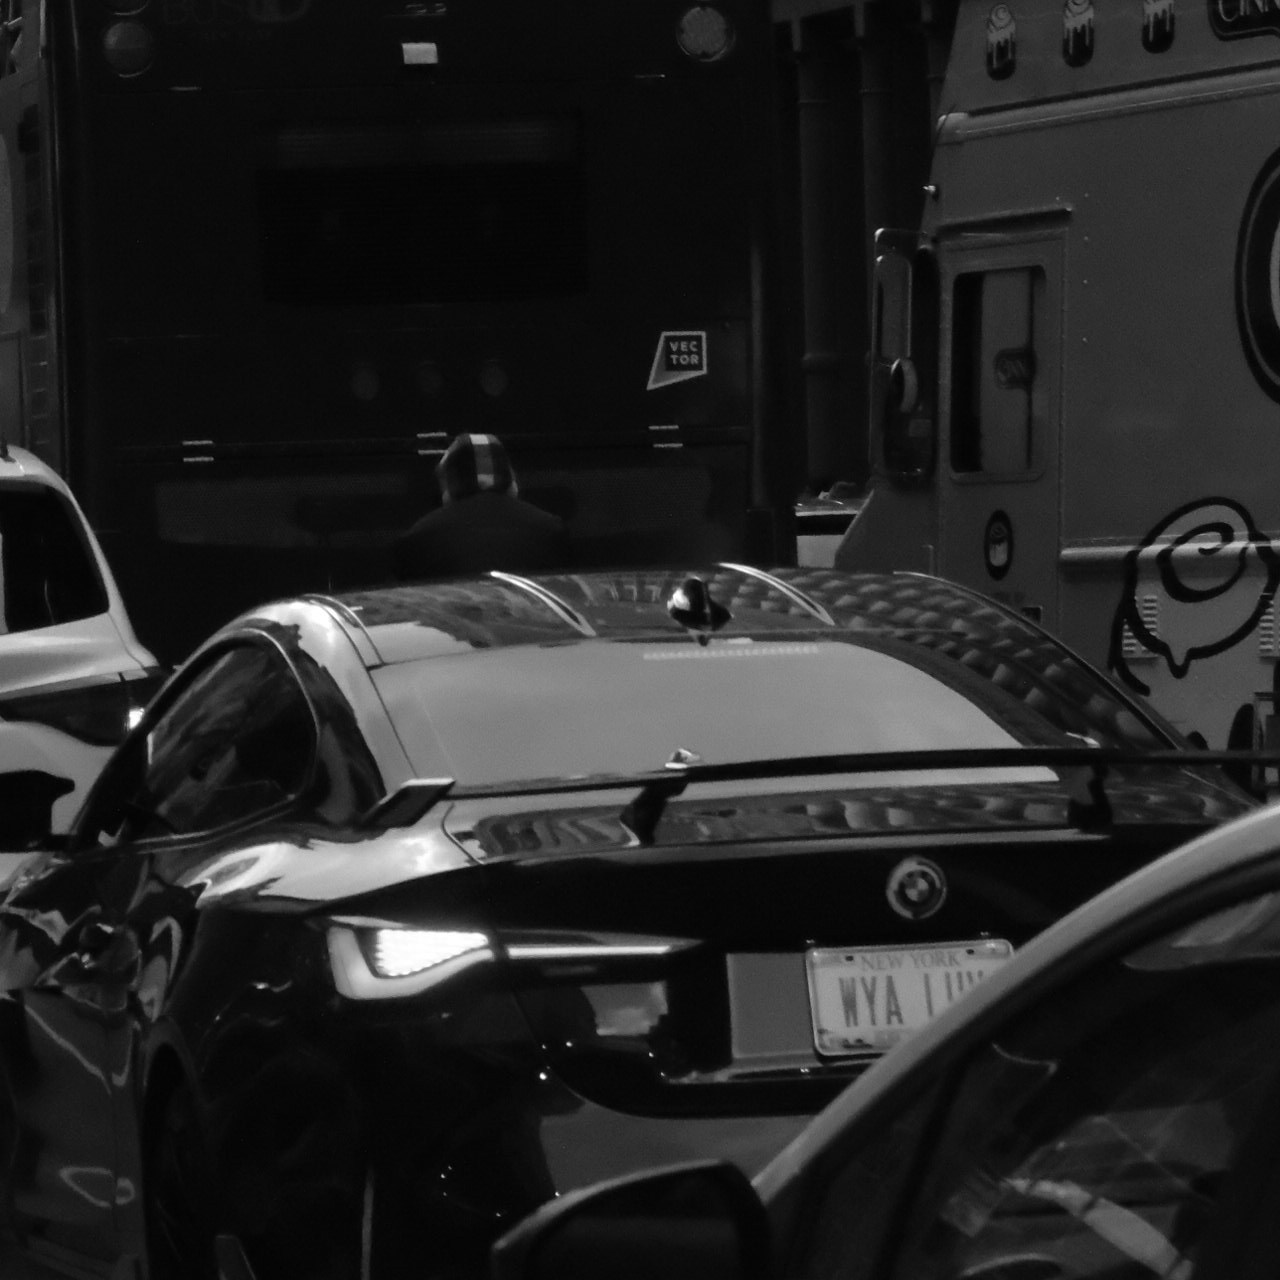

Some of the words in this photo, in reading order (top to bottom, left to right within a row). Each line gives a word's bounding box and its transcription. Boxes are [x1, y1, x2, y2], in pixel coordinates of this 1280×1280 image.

[669, 341, 698, 352] VEC
[669, 354, 700, 365] TOR
[861, 953, 904, 971] NEW
[910, 950, 962, 969] YORK
